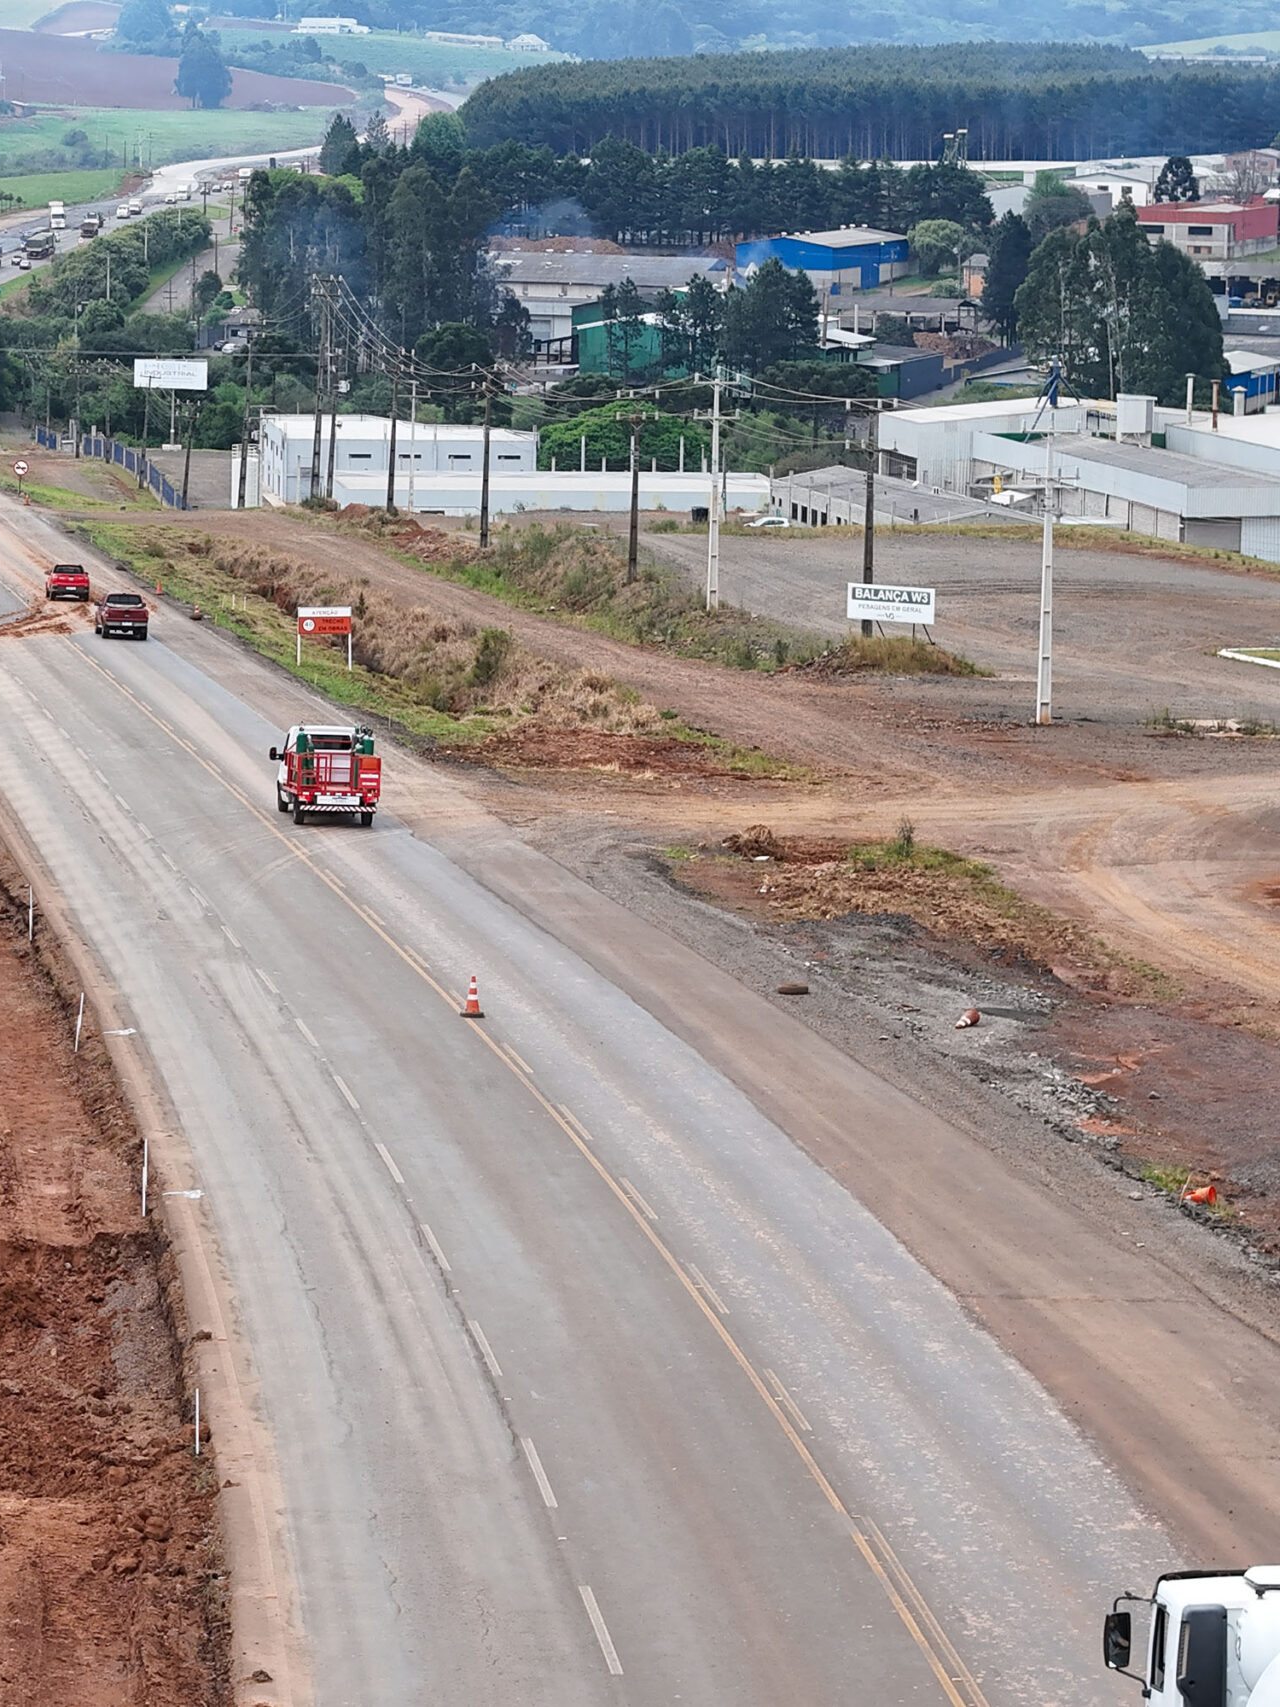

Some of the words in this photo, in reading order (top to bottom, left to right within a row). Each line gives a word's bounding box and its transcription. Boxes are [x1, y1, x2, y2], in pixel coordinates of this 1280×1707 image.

[855, 588, 909, 603] BALANÇA
[911, 592, 929, 603] W3
[858, 604, 890, 612] PESAGENS
